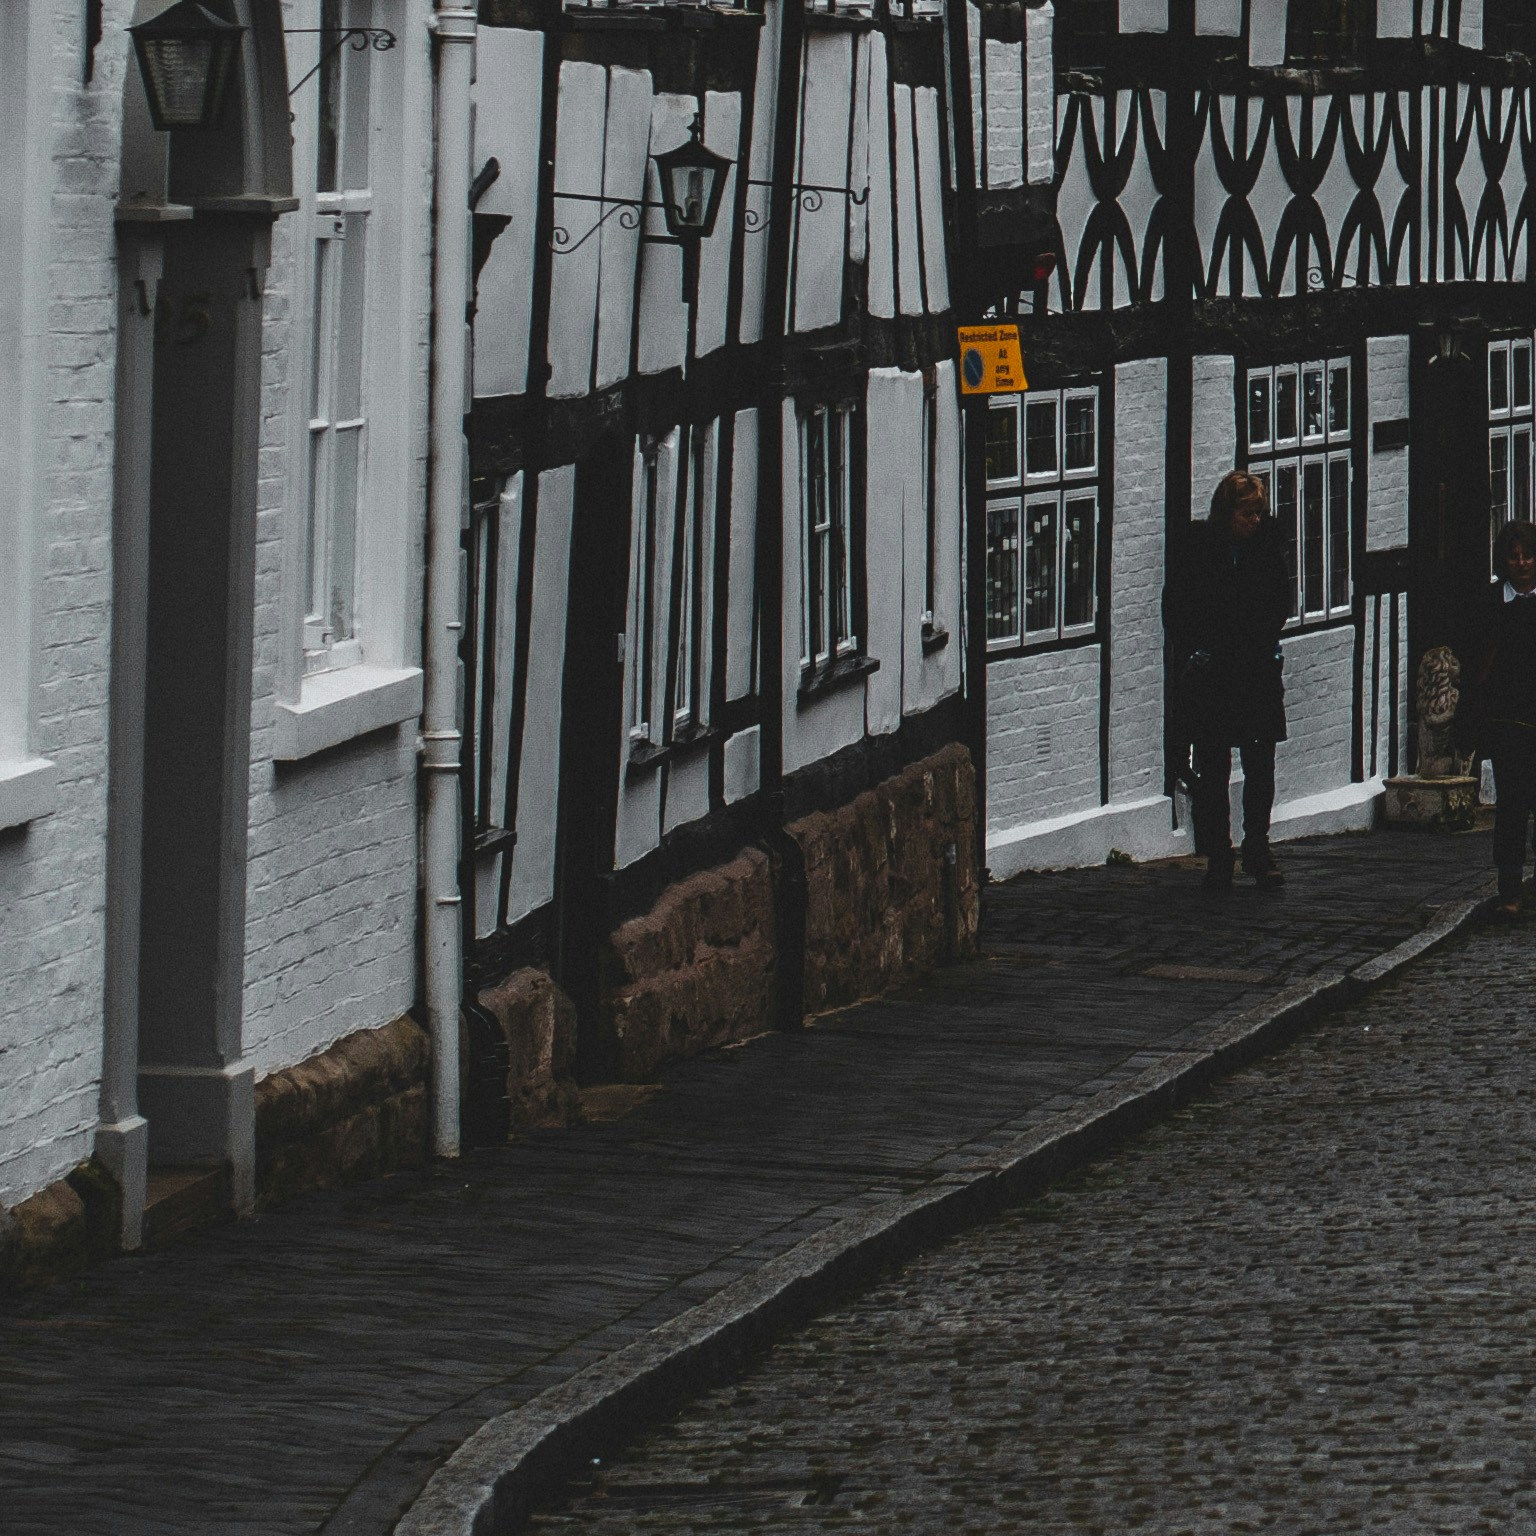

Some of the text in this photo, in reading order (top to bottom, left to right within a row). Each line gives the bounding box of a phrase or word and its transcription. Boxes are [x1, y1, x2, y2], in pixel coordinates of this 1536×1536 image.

[960, 330, 1018, 342] Restricted Zone
[999, 348, 1008, 359] At
[995, 364, 1009, 375] any
[995, 376, 1014, 386] time
